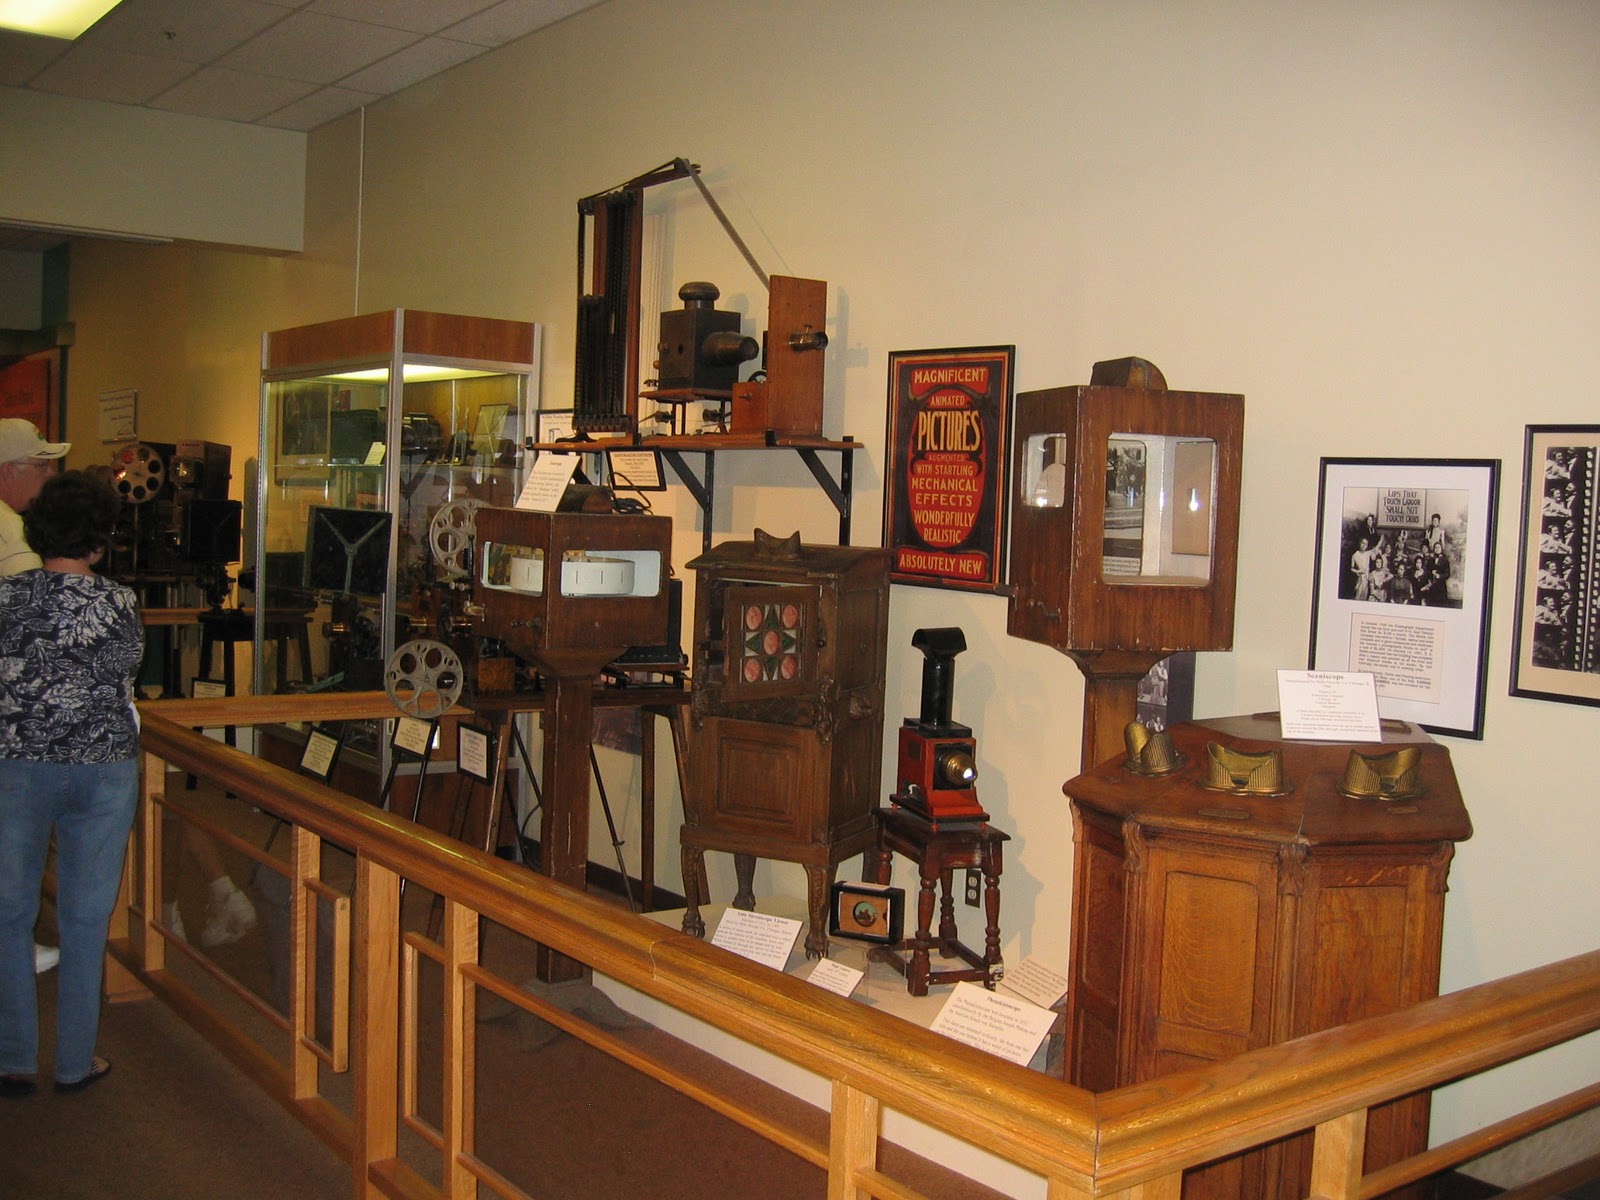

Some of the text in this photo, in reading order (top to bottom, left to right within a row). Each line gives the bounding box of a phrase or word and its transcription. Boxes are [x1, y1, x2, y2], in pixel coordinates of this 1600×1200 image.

[914, 367, 987, 384] MAGNIFICENT
[930, 395, 965, 406] ANIMATED
[917, 410, 981, 452] PICTURES
[928, 454, 966, 462] AUGMENTED
[916, 463, 974, 477] WITH STARTLING
[911, 477, 978, 492] MECHANICAL
[915, 493, 973, 507] EFFECTS
[914, 509, 976, 528] WONDERFULLY
[923, 528, 962, 544] REALISTIC
[899, 553, 982, 575] ABSOLUTELY NEW
